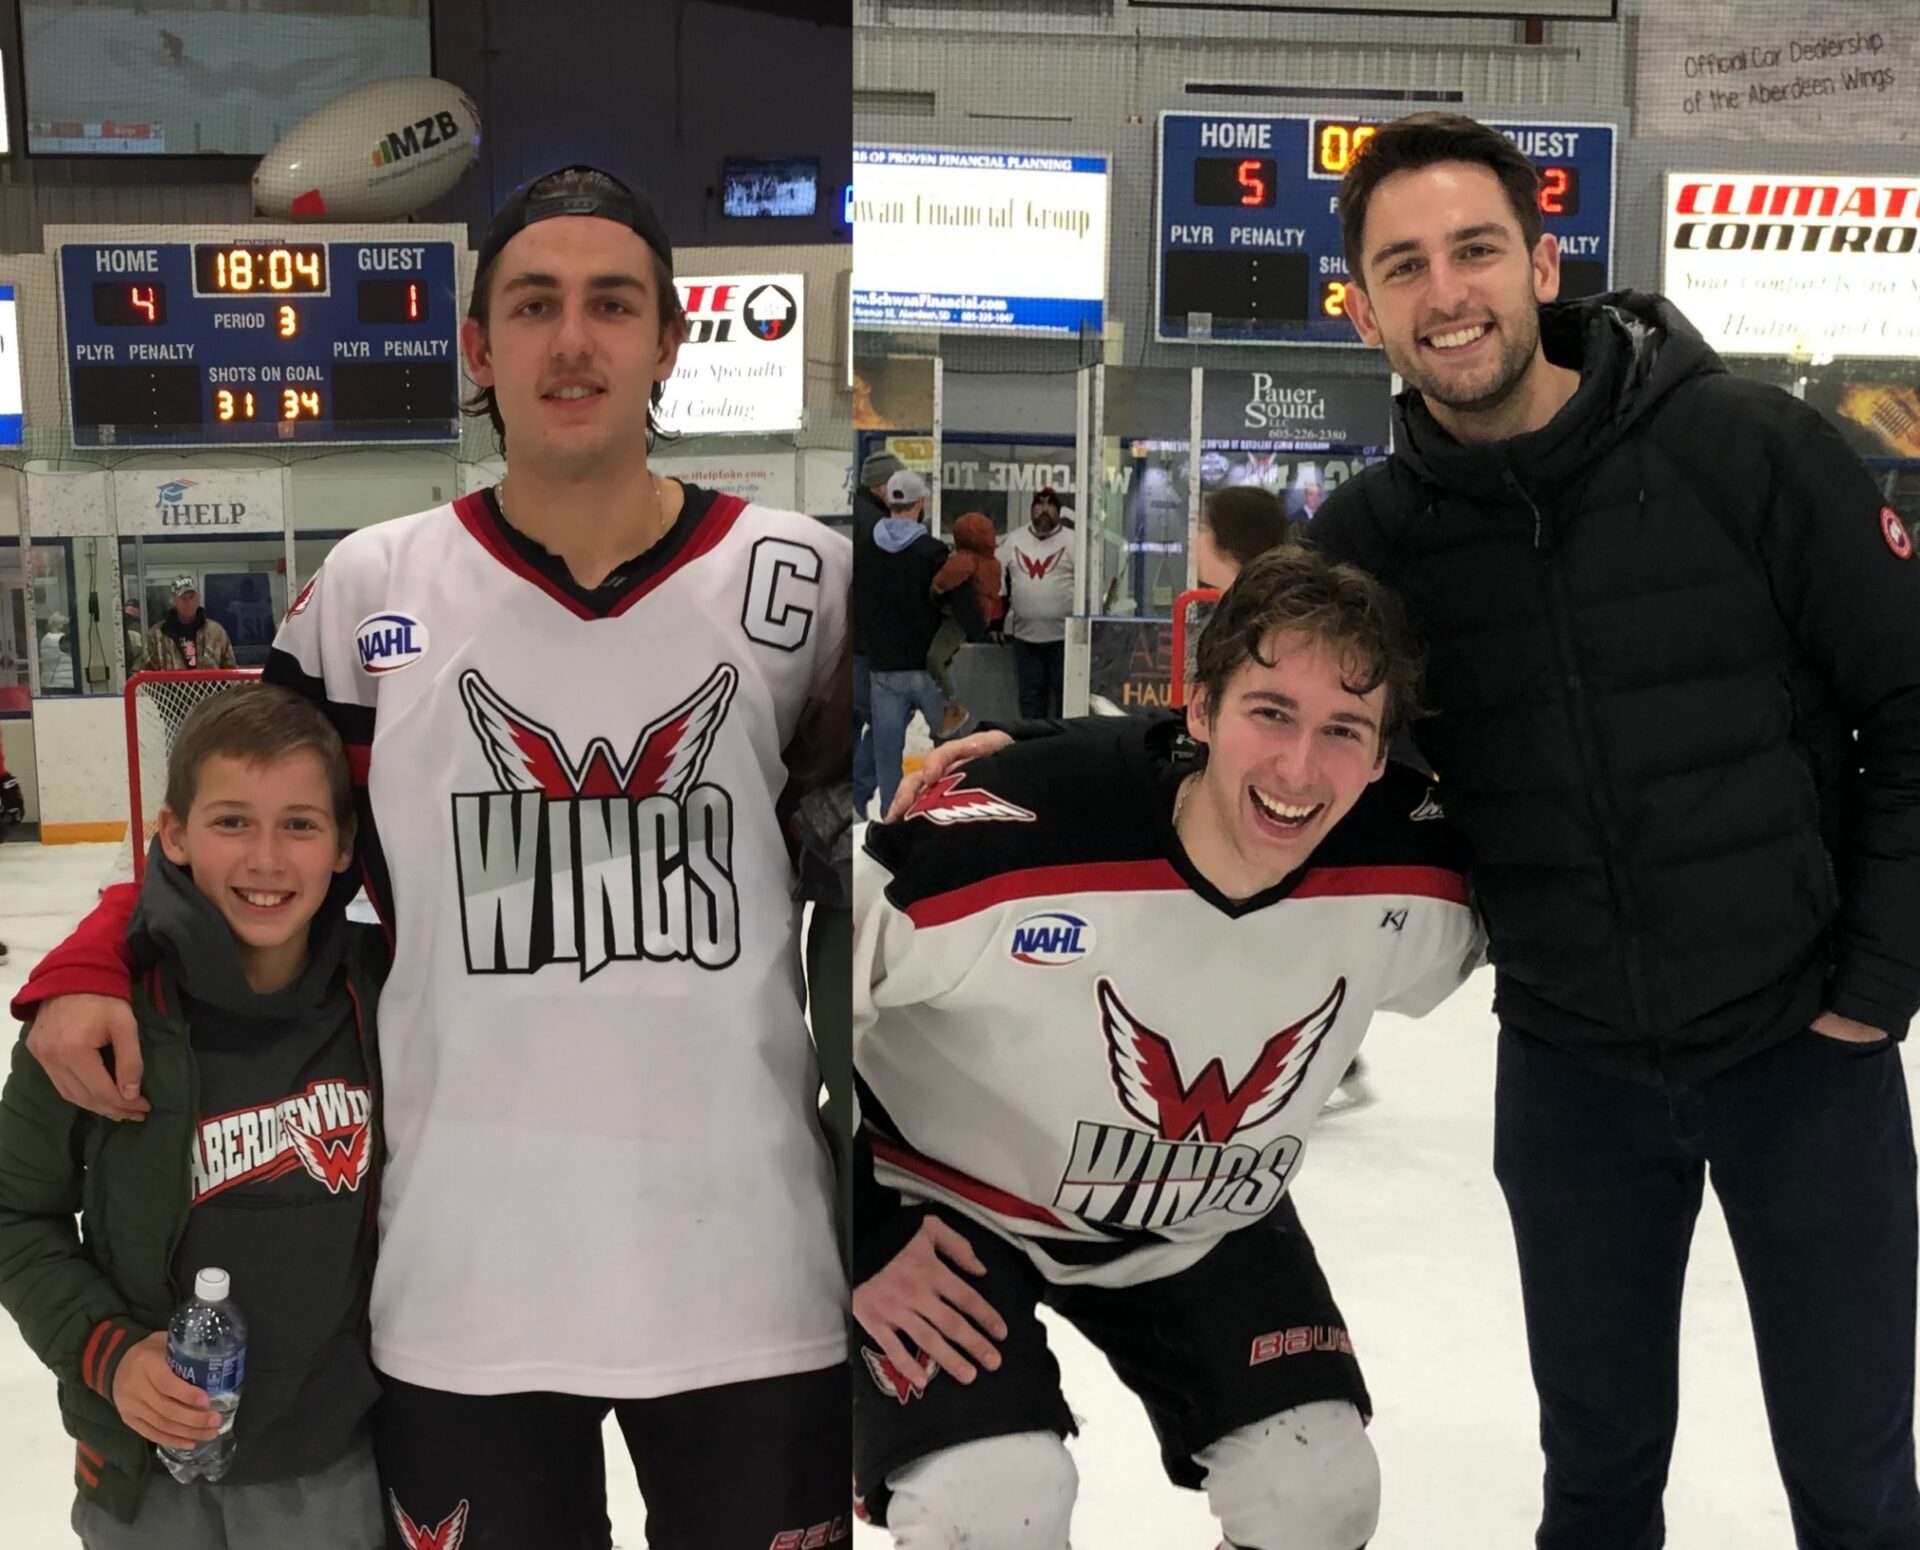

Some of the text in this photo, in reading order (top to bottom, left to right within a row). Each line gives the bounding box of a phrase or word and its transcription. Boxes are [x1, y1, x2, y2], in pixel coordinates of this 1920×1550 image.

[1684, 32, 1884, 78] Official Car Dealership
[1683, 67, 1895, 114] of the Aberdeen Wings
[387, 110, 459, 162] MZB
[1201, 123, 1272, 149] HOME
[887, 152, 937, 166] PROVEN
[939, 154, 1006, 168] FINANCIAL
[1007, 156, 1072, 171] PLANNING
[1238, 160, 1265, 205] 5
[1538, 167, 1568, 213] 2
[1676, 184, 1920, 218] CLIMAT
[1026, 200, 1090, 239] Group
[1170, 225, 1305, 246] PLYR PENALTY
[1558, 236, 1600, 254] ALTY
[1674, 222, 1920, 254] CONTRO
[95, 249, 159, 273] HOME
[217, 249, 320, 290] 18:04
[357, 247, 425, 271] GUEST
[132, 287, 154, 320] 4
[409, 284, 418, 317] 1
[853, 292, 1007, 311] w.SchwanFinancial.com
[214, 313, 265, 329] PERIOD
[280, 305, 296, 337] 3
[76, 343, 195, 360] PLYR PENALTY
[333, 339, 449, 358] PLYR PENALTY
[208, 365, 324, 382] SHOTS ON GOAL
[1251, 372, 1317, 403] Pauer
[218, 389, 254, 421] 31
[284, 388, 319, 419] 34
[1244, 398, 1325, 428] Sound
[1268, 429, 1347, 441] 605-226-2380
[670, 470, 767, 481] ww.iHelpLoan.com
[161, 503, 246, 527] iHELP
[741, 536, 823, 652] C
[357, 626, 422, 665] NAHL
[1123, 682, 1172, 707] HAU
[451, 782, 741, 983] WINGS
[1011, 926, 1086, 954] NAHL
[1053, 1120, 1303, 1229] WINGS
